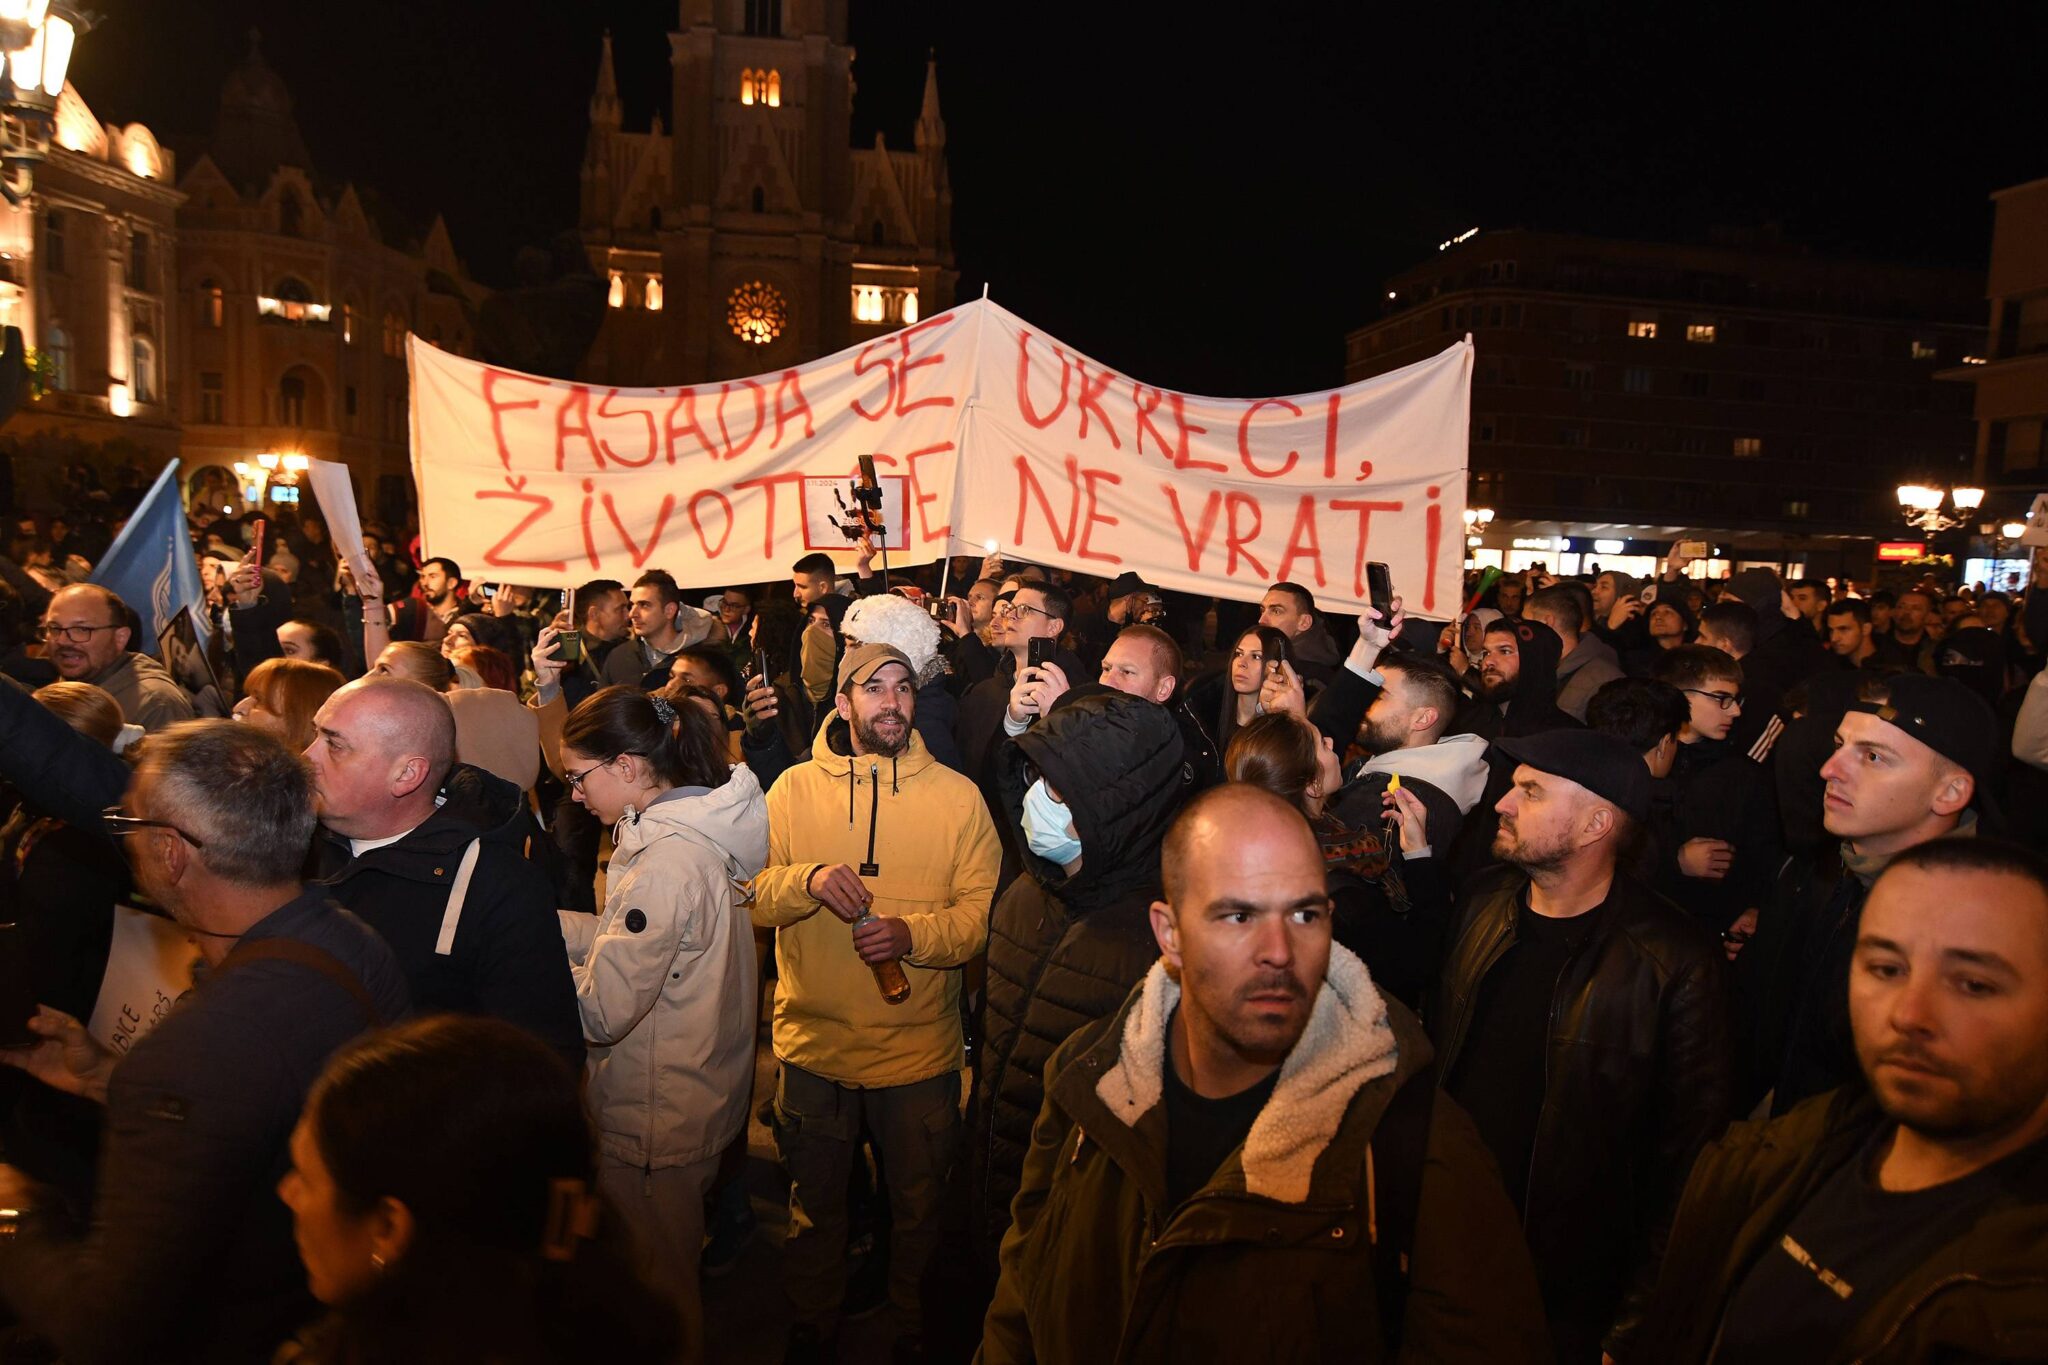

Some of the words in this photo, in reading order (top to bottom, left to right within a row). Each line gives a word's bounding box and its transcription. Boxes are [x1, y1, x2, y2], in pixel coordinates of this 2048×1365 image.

[482, 366, 816, 471] FASADA
[851, 313, 955, 422] SE
[850, 441, 955, 542] E
[1012, 453, 1122, 565] NE
